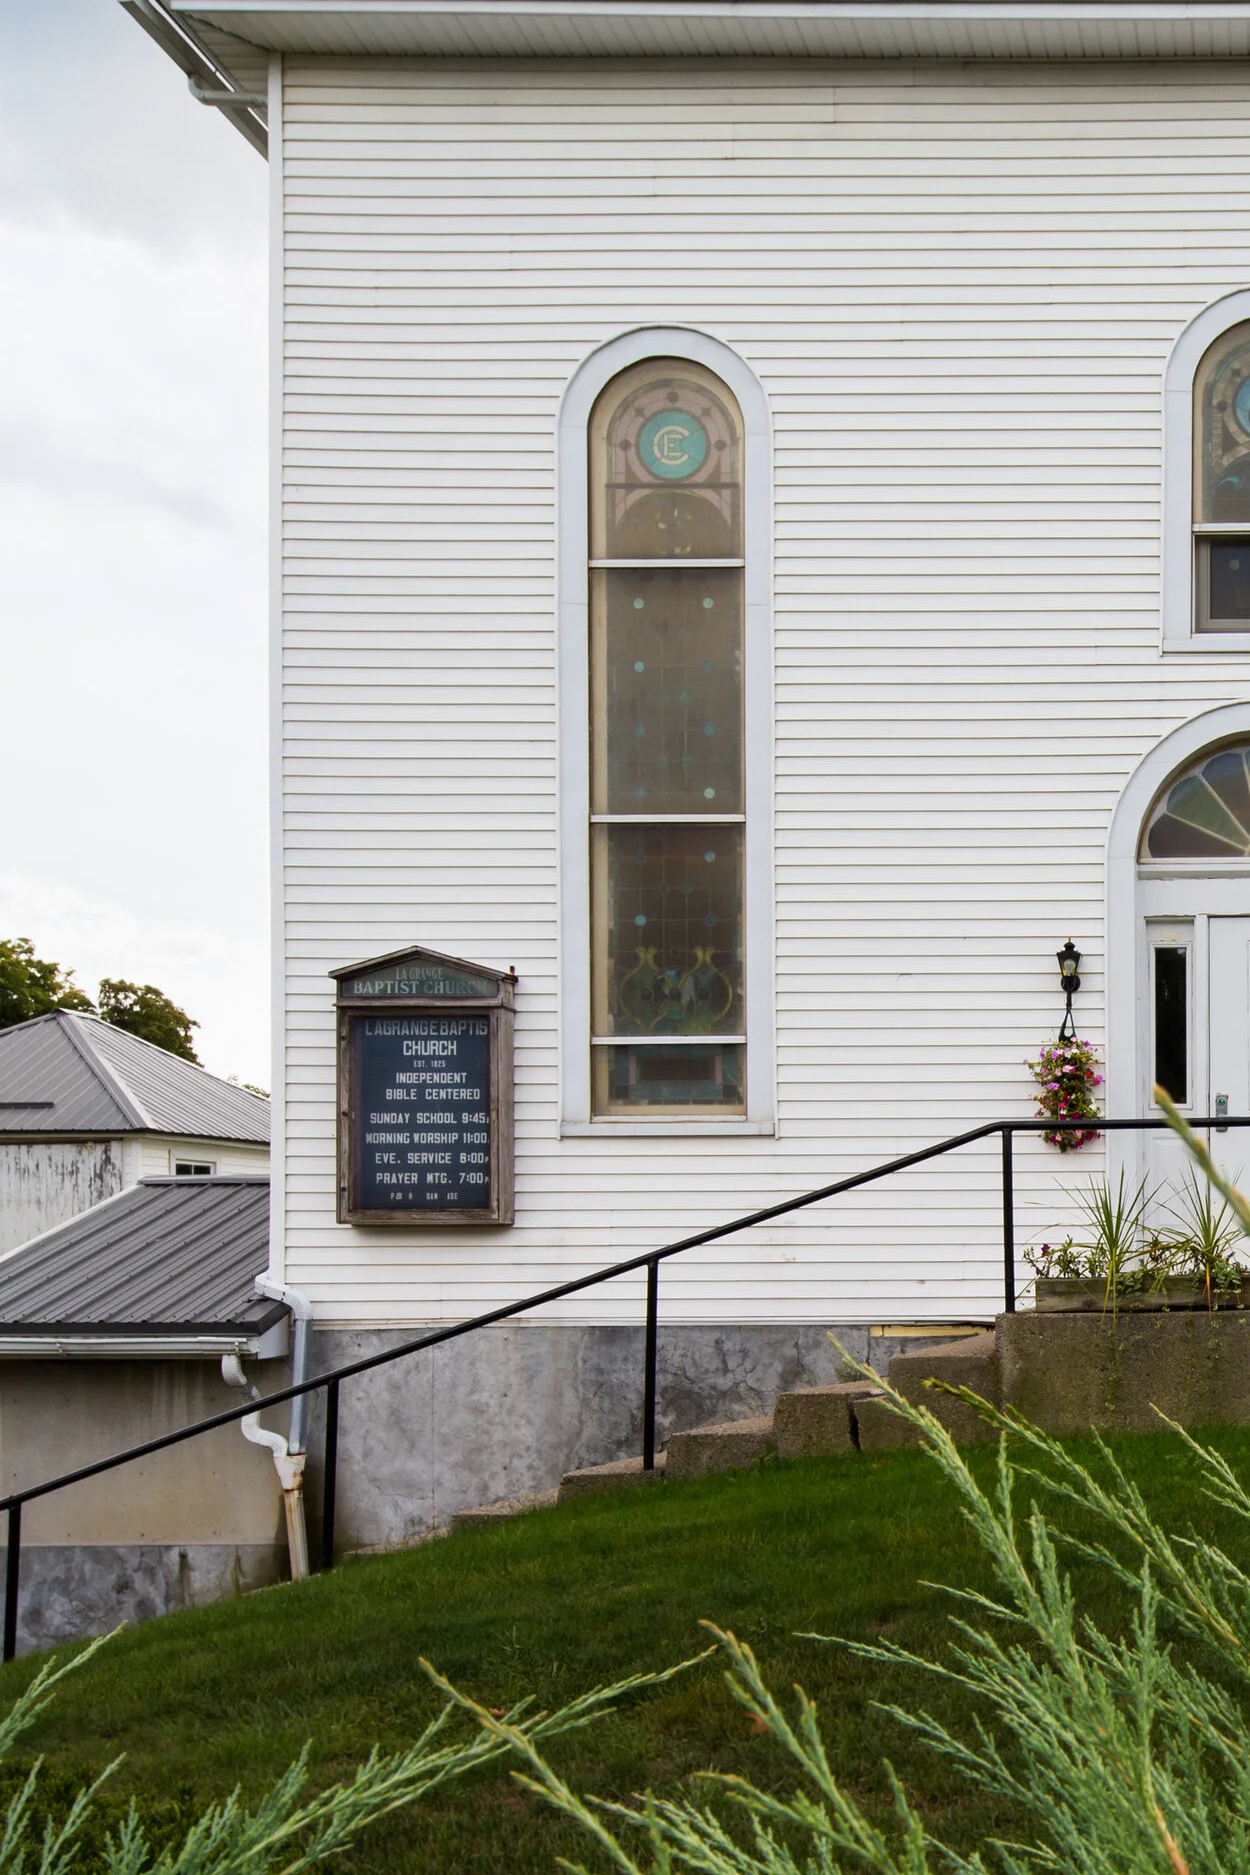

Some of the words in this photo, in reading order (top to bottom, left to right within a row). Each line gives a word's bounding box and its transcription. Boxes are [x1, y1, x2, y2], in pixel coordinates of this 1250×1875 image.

[395, 967, 407, 980] LA
[353, 980, 420, 994] BAPTIST
[402, 1040, 457, 1056] CHURCH
[413, 1060, 428, 1068] EST.
[431, 1060, 446, 1068] 1825
[396, 1072, 467, 1084] INDEPENDENT
[385, 1088, 417, 1100] BIBLE
[425, 1088, 481, 1100] CENTERED
[370, 1112, 410, 1124] SUNDAY
[416, 1112, 457, 1124] SCHOOL
[366, 1132, 410, 1144] MORNING
[413, 1132, 458, 1144] WORSHIP
[375, 1152, 401, 1164] EVE.
[407, 1152, 452, 1164] SERVICE
[376, 1172, 418, 1184] PRAYER
[426, 1172, 452, 1184] MTG.
